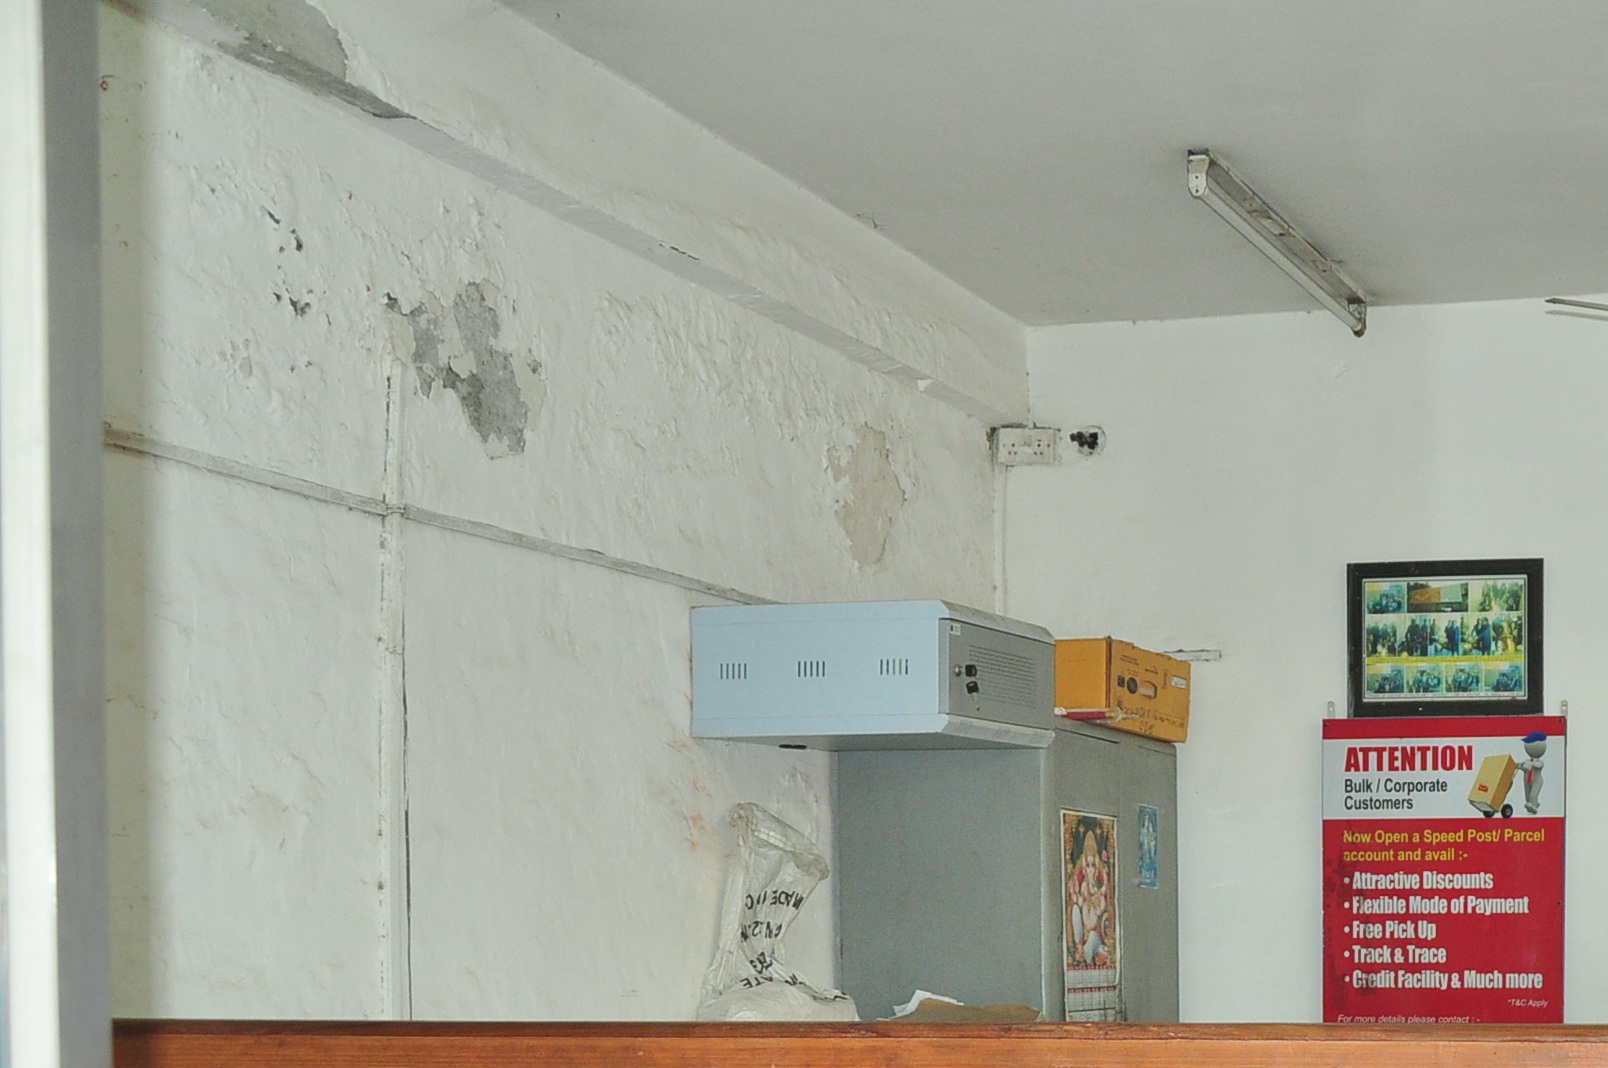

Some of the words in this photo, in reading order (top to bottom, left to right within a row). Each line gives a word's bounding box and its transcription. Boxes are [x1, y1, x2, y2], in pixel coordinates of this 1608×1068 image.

[1345, 745, 1473, 772] ATTENTION
[1344, 779, 1375, 793] Bulk
[1376, 779, 1383, 793] /
[1384, 778, 1448, 796] Corporate
[1343, 796, 1414, 810] Customers
[1344, 830, 1371, 843] Now
[1375, 830, 1408, 846] Open
[1412, 833, 1419, 843] a
[1424, 829, 1463, 845] Speed
[1505, 828, 1544, 842] Parcel
[1344, 849, 1394, 861] account
[1398, 848, 1421, 861] and
[1425, 848, 1454, 861] avail
[1352, 871, 1420, 889] Attractive
[1422, 871, 1494, 889] Discounts
[1352, 896, 1407, 914] Flexible
[1409, 896, 1448, 914] Mode
[1450, 895, 1465, 914] of
[1467, 896, 1529, 915] Payment
[1352, 920, 1383, 939] Free
[1385, 920, 1416, 938] Pick
[1418, 920, 1436, 940] Up
[1352, 945, 1392, 963] Track
[1394, 948, 1404, 963] &
[1406, 945, 1446, 963] Trace
[1352, 970, 1396, 988] Credit
[1398, 970, 1449, 990] Facility
[1451, 973, 1461, 988] &
[1464, 970, 1503, 988] Much
[1505, 973, 1543, 989] more
[1528, 999, 1548, 1008] Apply
[1337, 1015, 1353, 1023] For
[1378, 1015, 1405, 1023] details
[1407, 1015, 1442, 1023] please
[1444, 1015, 1470, 1023] contact
